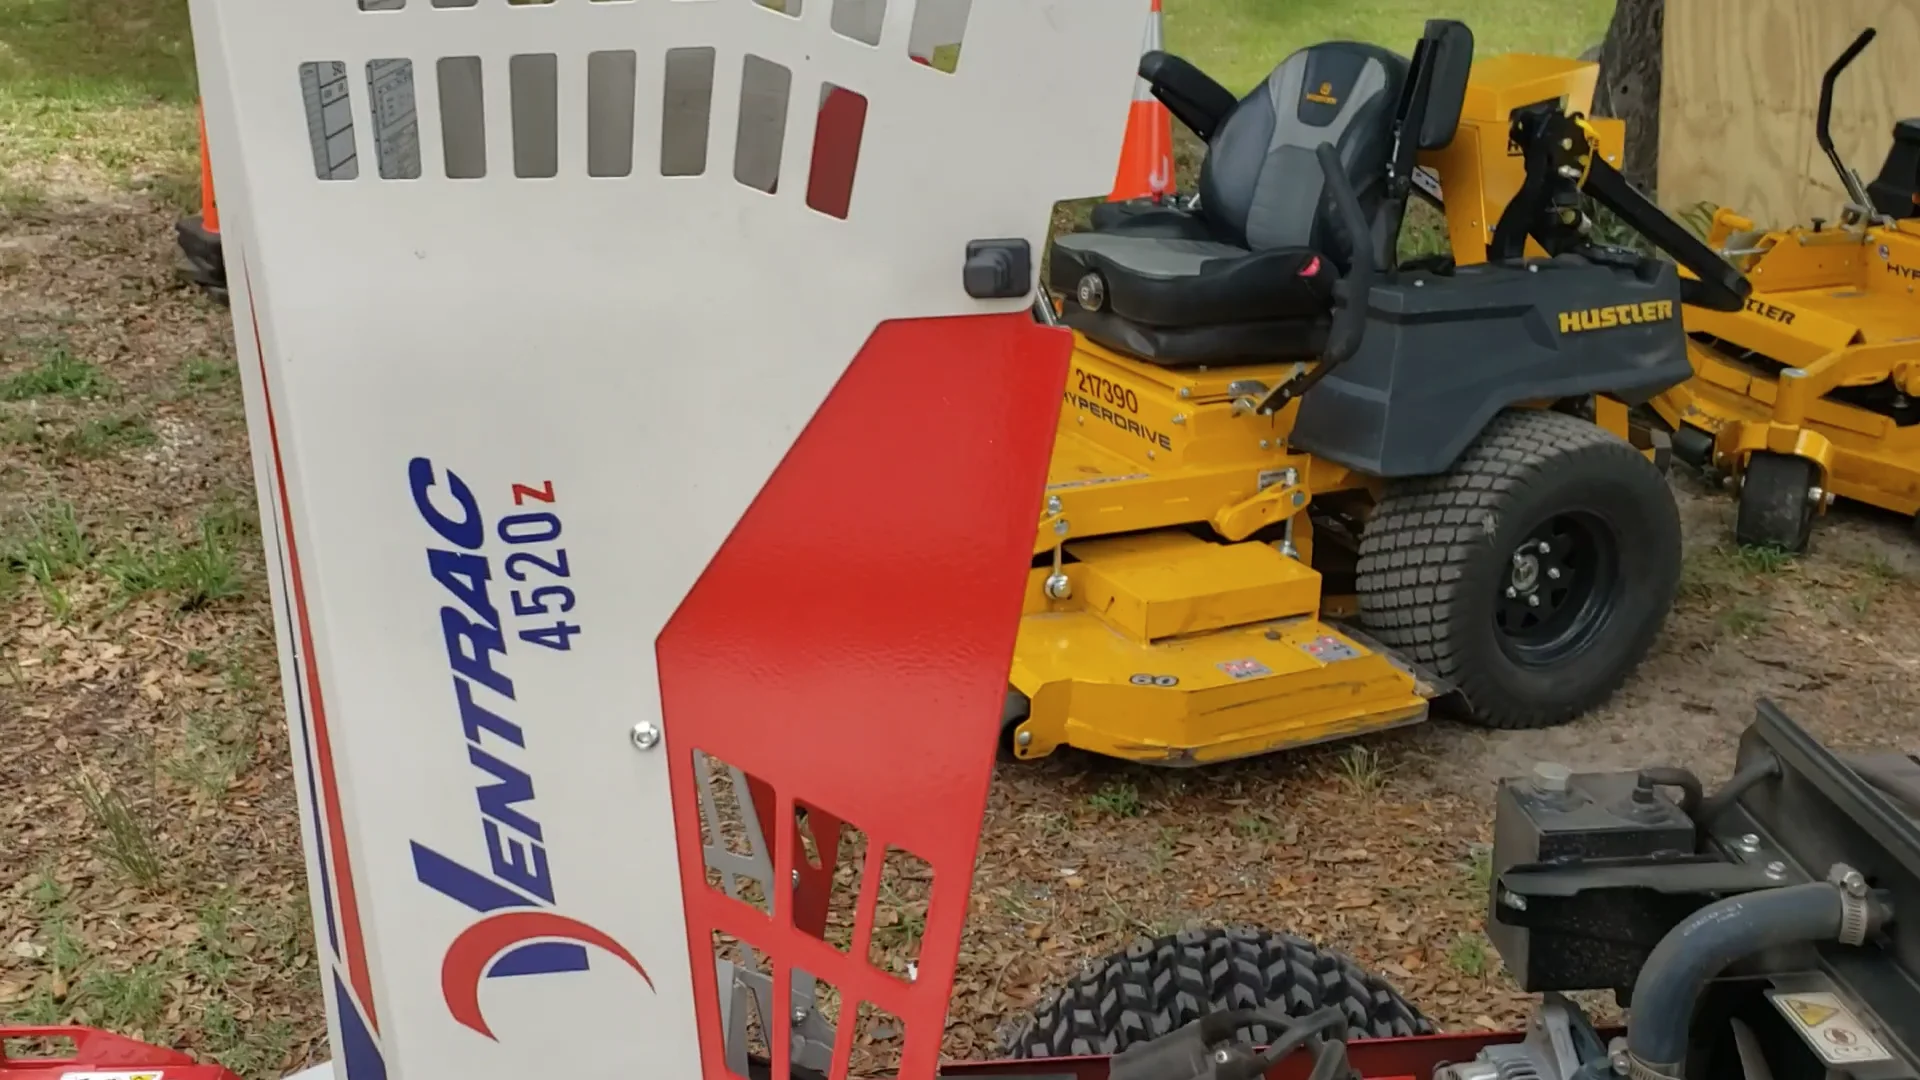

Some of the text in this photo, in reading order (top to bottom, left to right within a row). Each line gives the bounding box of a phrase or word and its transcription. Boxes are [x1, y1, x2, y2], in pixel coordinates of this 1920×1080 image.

[1887, 262, 1920, 280] HYP
[1558, 300, 1673, 333] HUSTLER
[1746, 299, 1796, 325] TLER
[1076, 368, 1138, 414] 217390
[408, 457, 556, 912] VENTRAC
